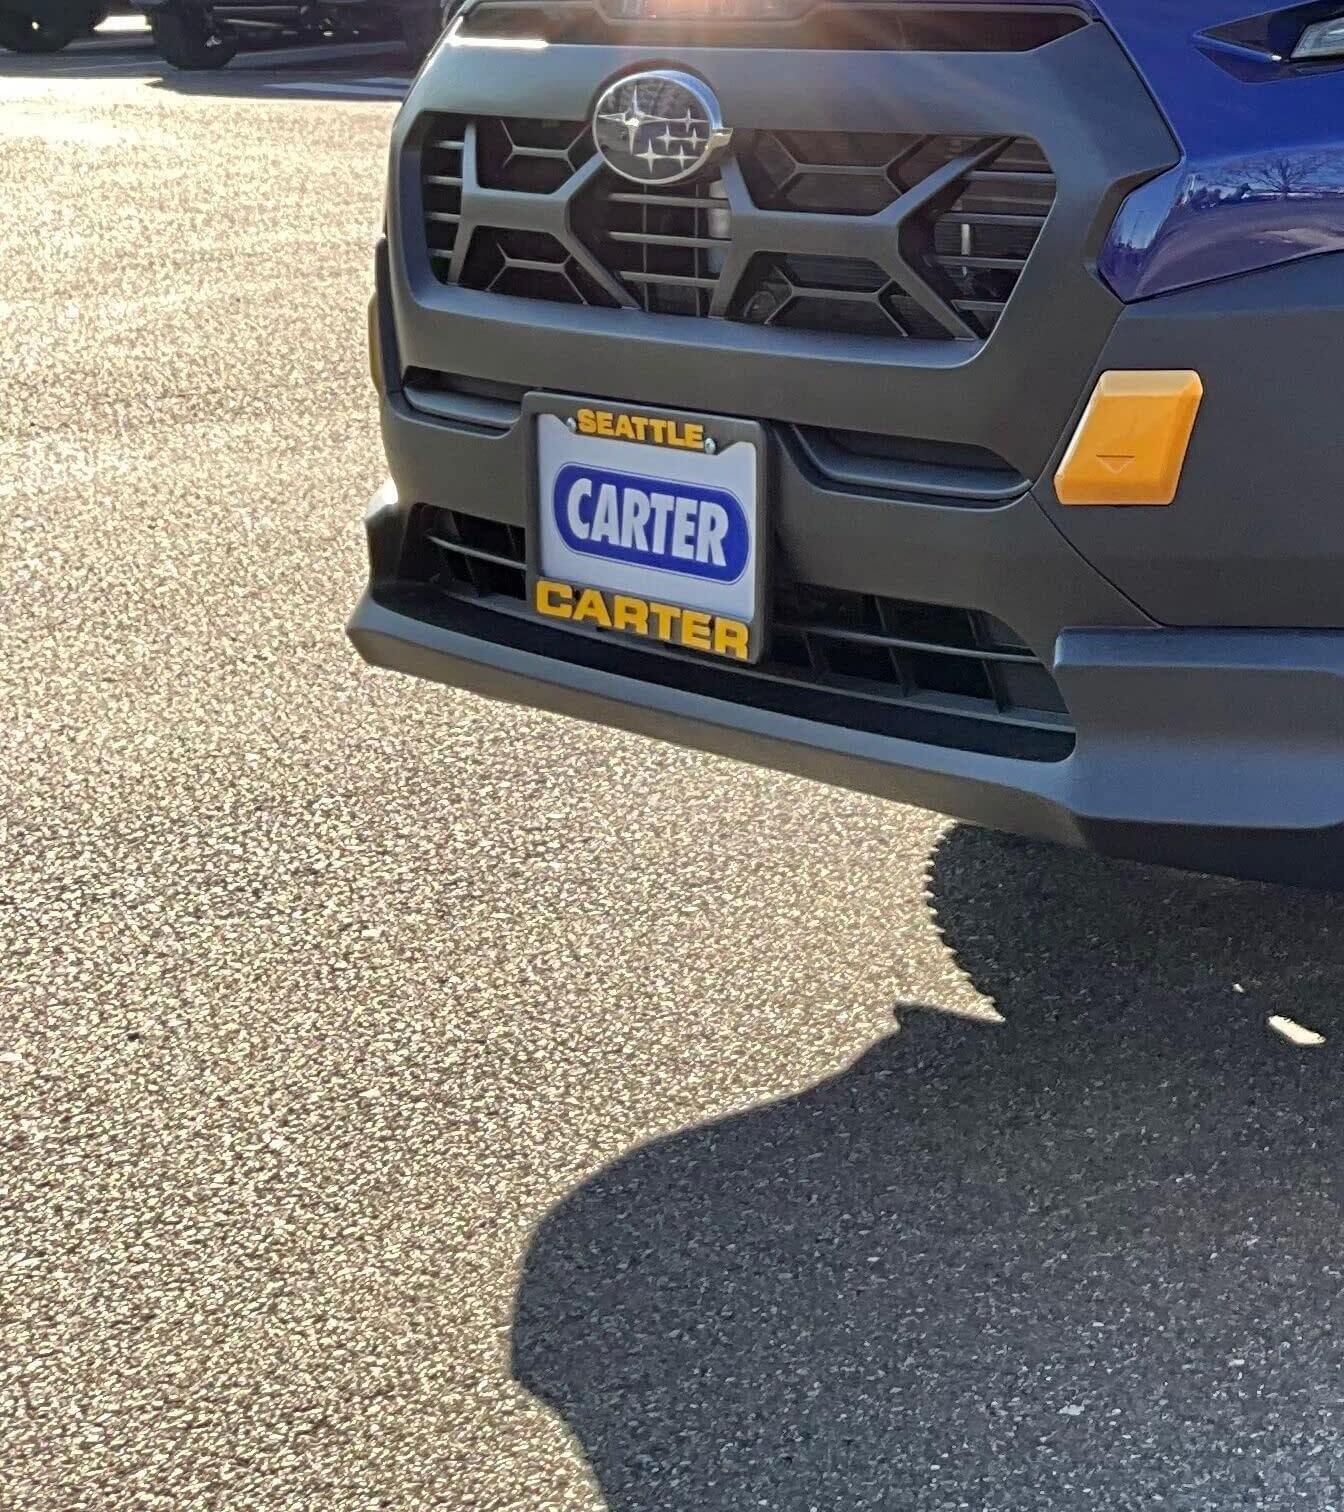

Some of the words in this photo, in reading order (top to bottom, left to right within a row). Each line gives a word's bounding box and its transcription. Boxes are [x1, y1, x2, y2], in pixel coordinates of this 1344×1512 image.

[577, 408, 705, 450] SEATTLE
[567, 478, 729, 567] CARTER
[536, 580, 749, 660] CARTER
